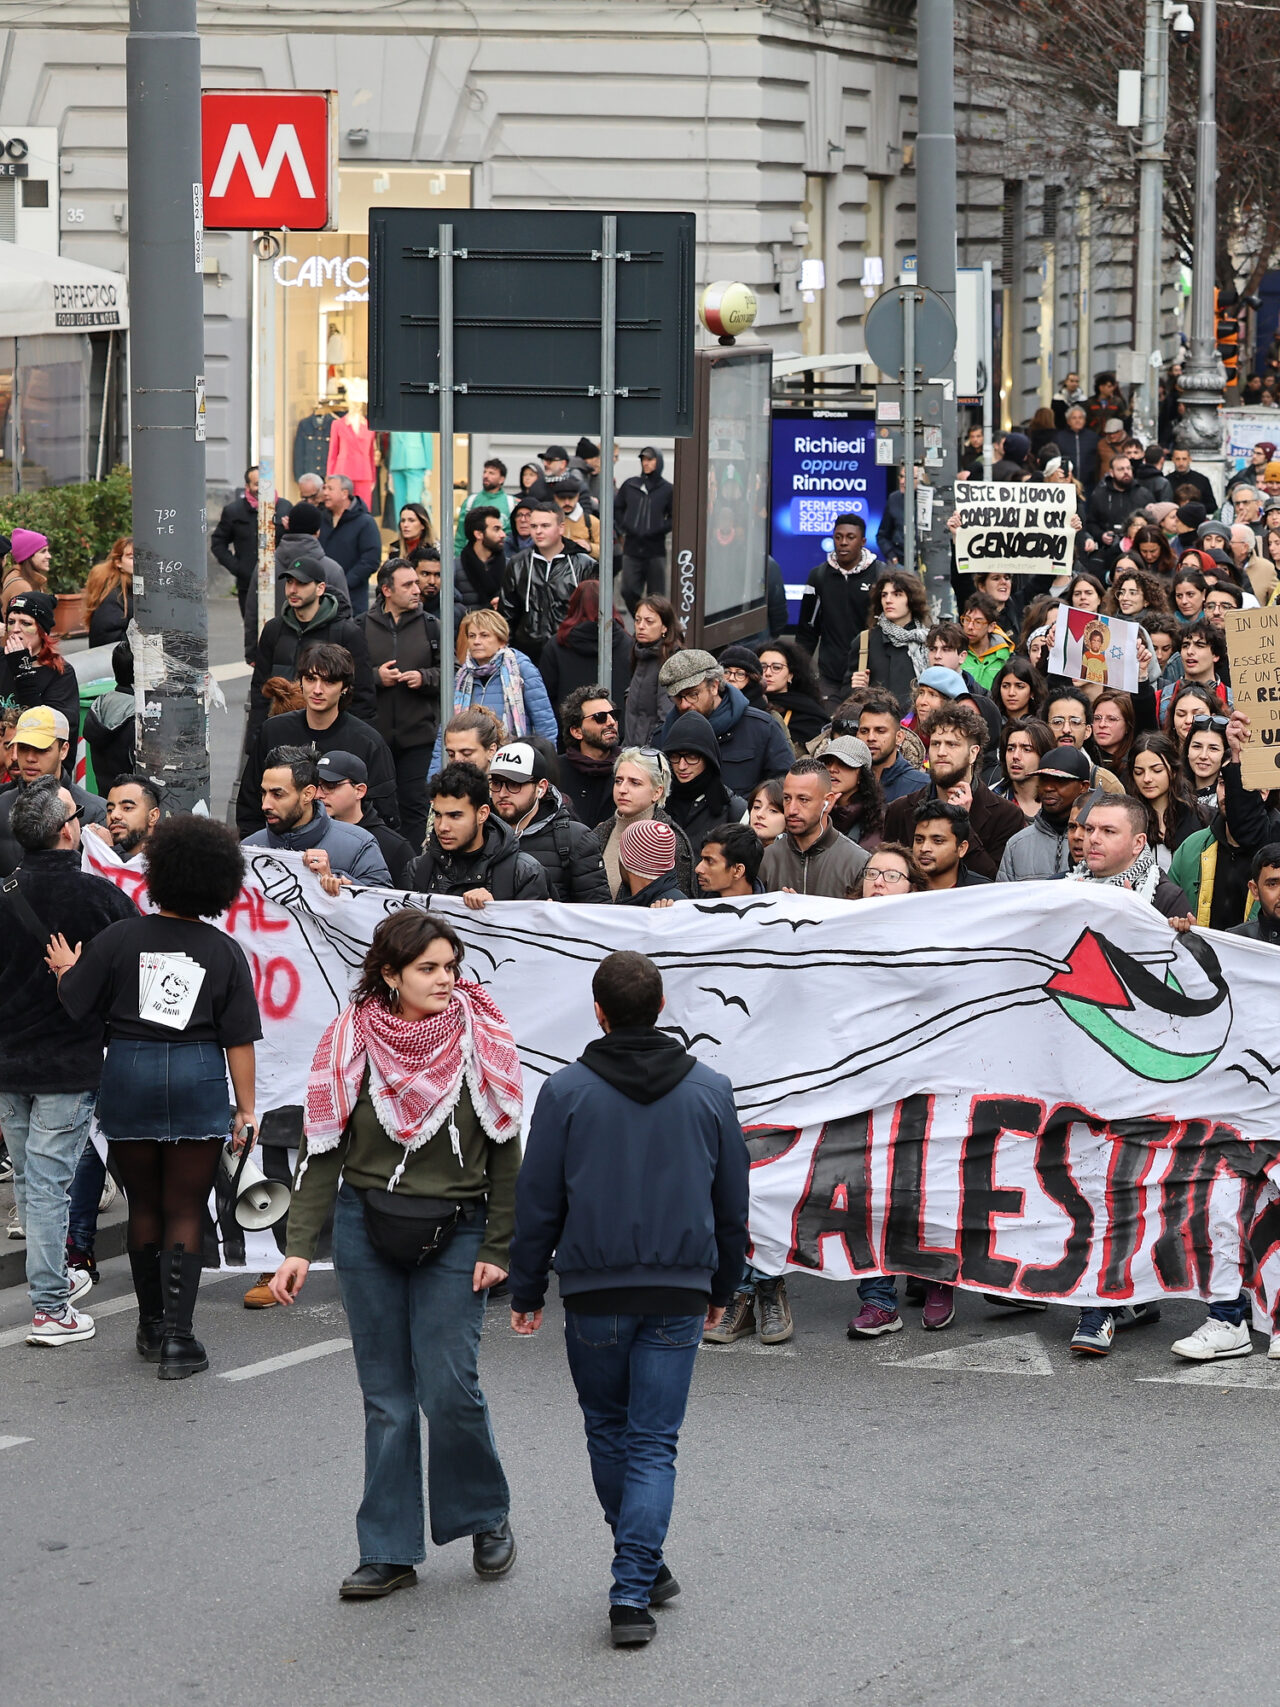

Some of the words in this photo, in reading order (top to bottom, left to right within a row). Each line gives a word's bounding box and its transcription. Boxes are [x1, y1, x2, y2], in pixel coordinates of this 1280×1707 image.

[209, 123, 316, 198] M
[67, 208, 84, 222] 35
[794, 437, 866, 454] Richiedi
[801, 459, 859, 475] oppure
[792, 474, 867, 492] Rinnova
[999, 486, 1016, 503] DI
[1019, 486, 1066, 504] NUOVO
[800, 500, 863, 513] PERMESSO
[154, 508, 177, 523] 730
[800, 511, 839, 523] SOSTA
[800, 521, 836, 533] RESID
[967, 531, 1068, 561] GENOCIDIO
[157, 561, 183, 574] 760
[1235, 617, 1251, 632] IN
[1259, 613, 1278, 629] UN
[1259, 634, 1275, 649] IN
[1233, 652, 1277, 667] ESSERE
[1254, 670, 1272, 683] UN
[1237, 689, 1252, 702] LA
[495, 752, 522, 765] FILA
[162, 1007, 180, 1016] ANNI
